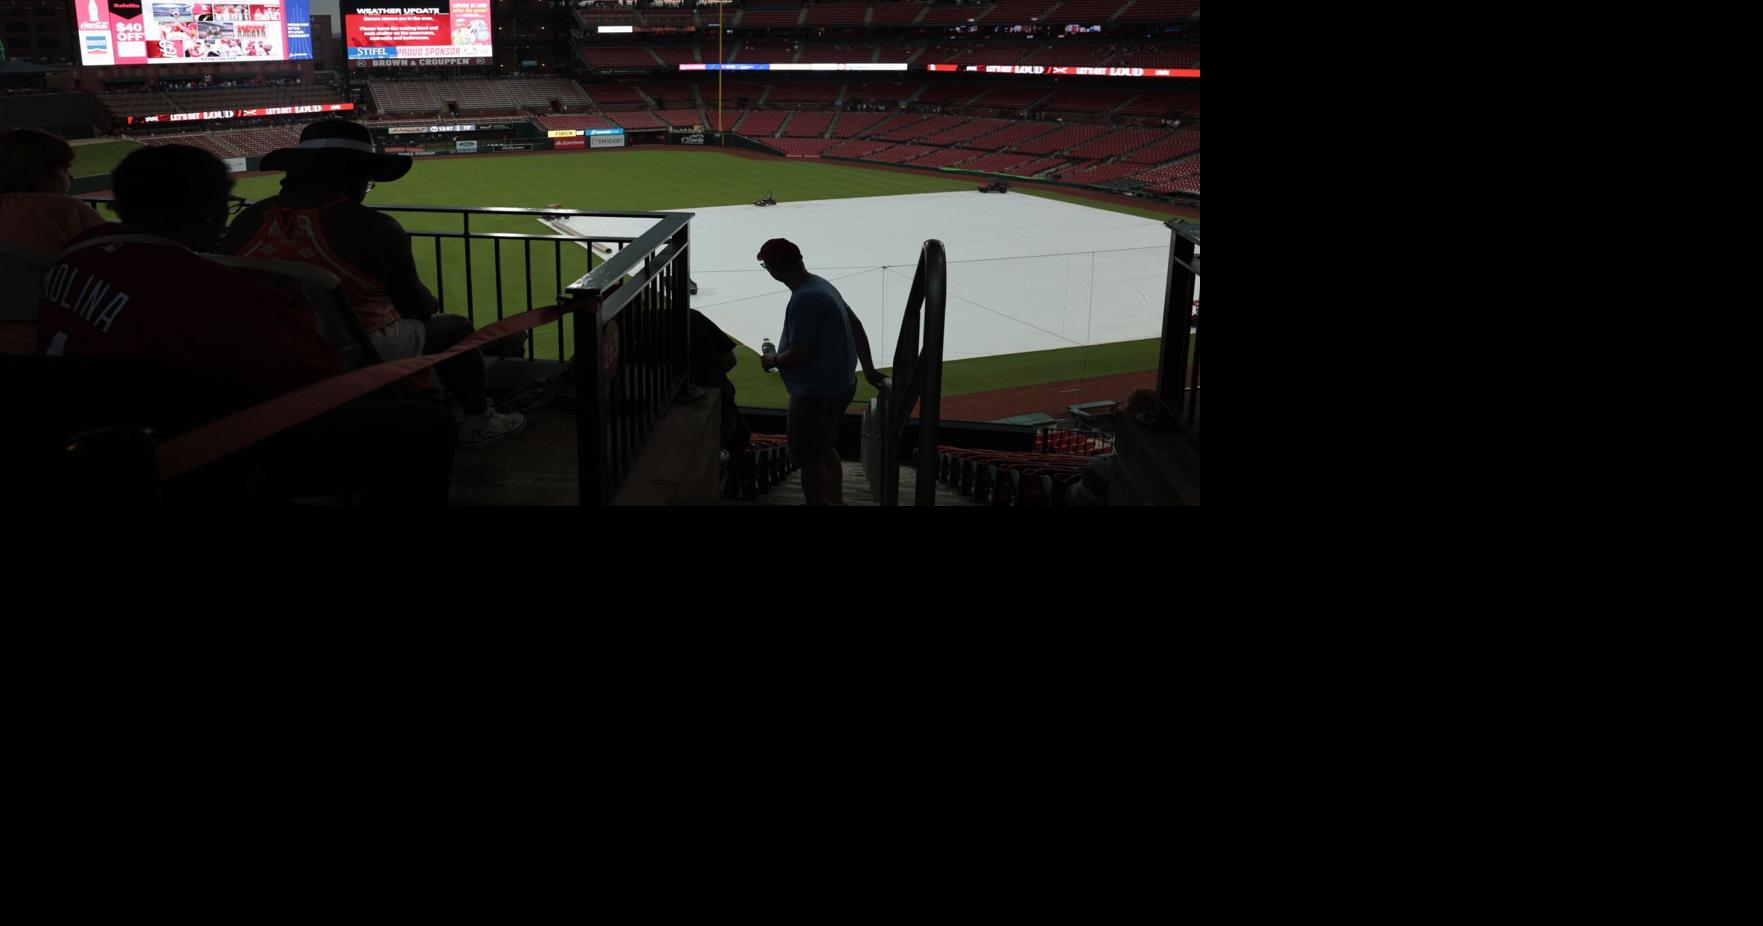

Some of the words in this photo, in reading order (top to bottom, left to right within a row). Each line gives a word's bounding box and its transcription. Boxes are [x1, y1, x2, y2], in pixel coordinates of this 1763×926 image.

[116, 22, 142, 32] $40
[117, 32, 144, 41] OFF
[357, 47, 388, 56] STIFEL
[397, 48, 423, 57] PROUD
[424, 48, 460, 56] SPONSOR
[1015, 65, 1044, 74] LOUD
[1110, 68, 1144, 76] LOUD
[295, 105, 322, 113] LOUD
[204, 111, 234, 119] LOUD
